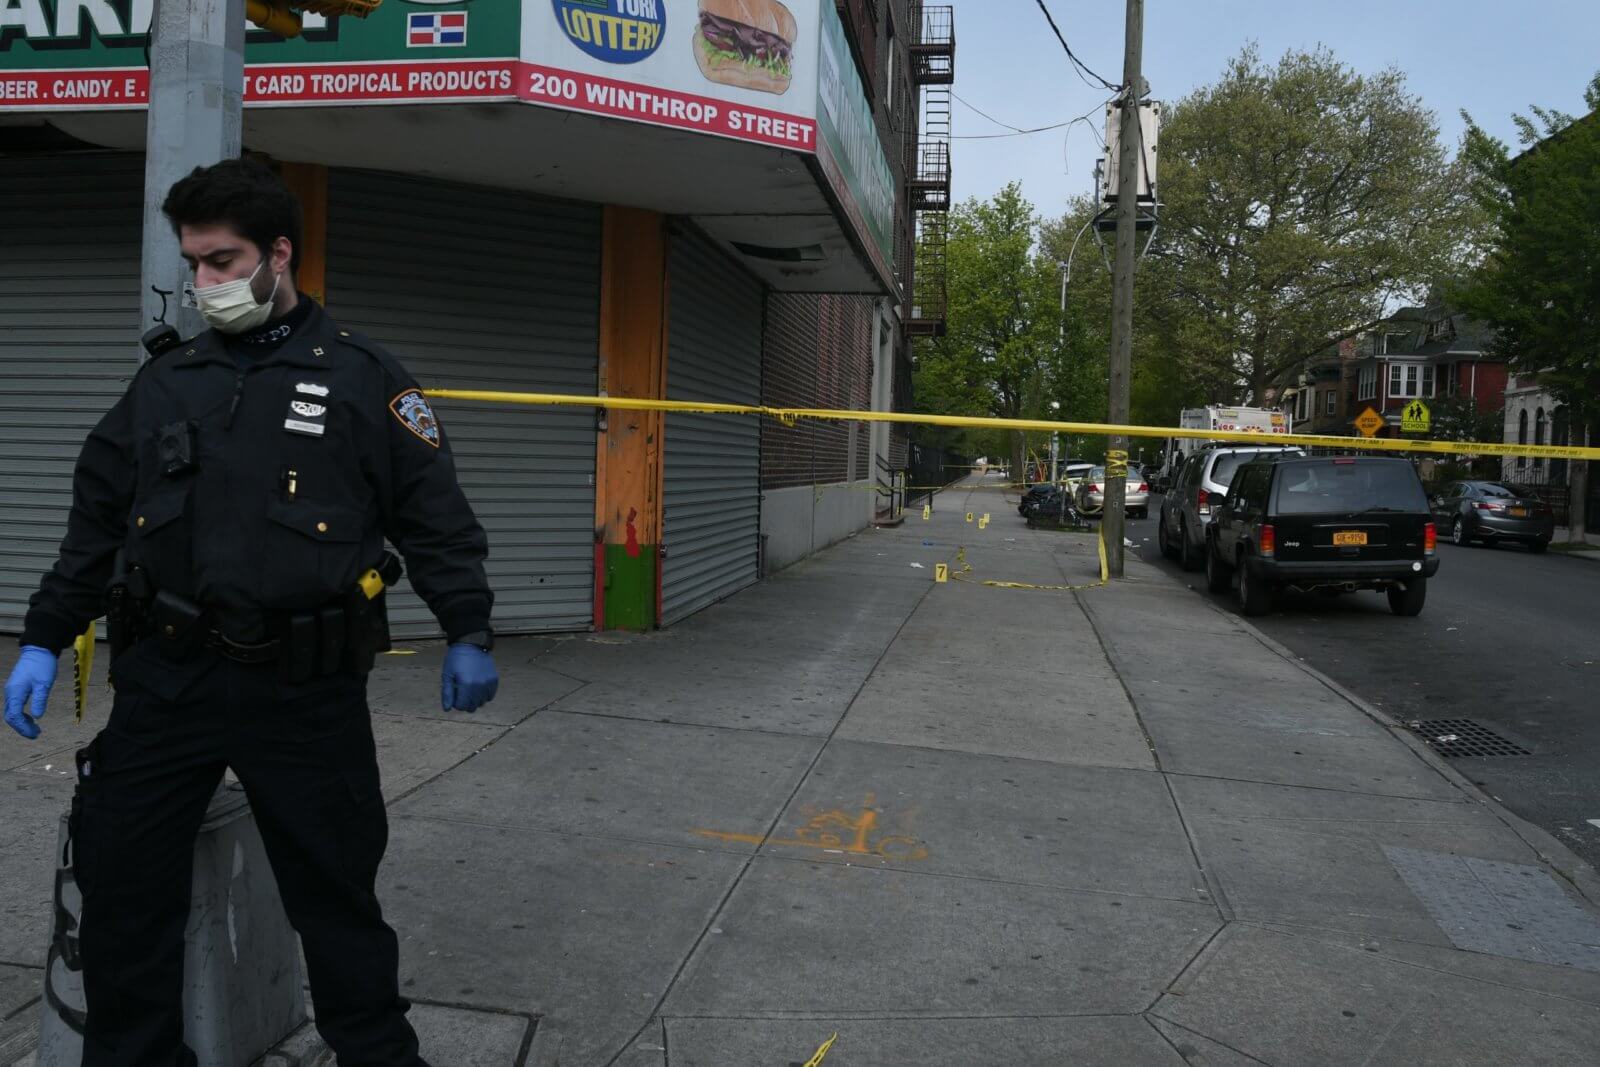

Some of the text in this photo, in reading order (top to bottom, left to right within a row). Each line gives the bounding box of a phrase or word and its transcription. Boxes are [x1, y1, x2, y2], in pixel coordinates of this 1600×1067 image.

[561, 6, 662, 51] LOTTERY
[255, 74, 306, 95] CARD
[310, 72, 403, 94] TROPICAL
[407, 69, 512, 92] PRODUCTS
[529, 72, 813, 143] 200 WINTHROP STREET
[1403, 422, 1426, 430] SCHOOL
[937, 565, 946, 579] 7
